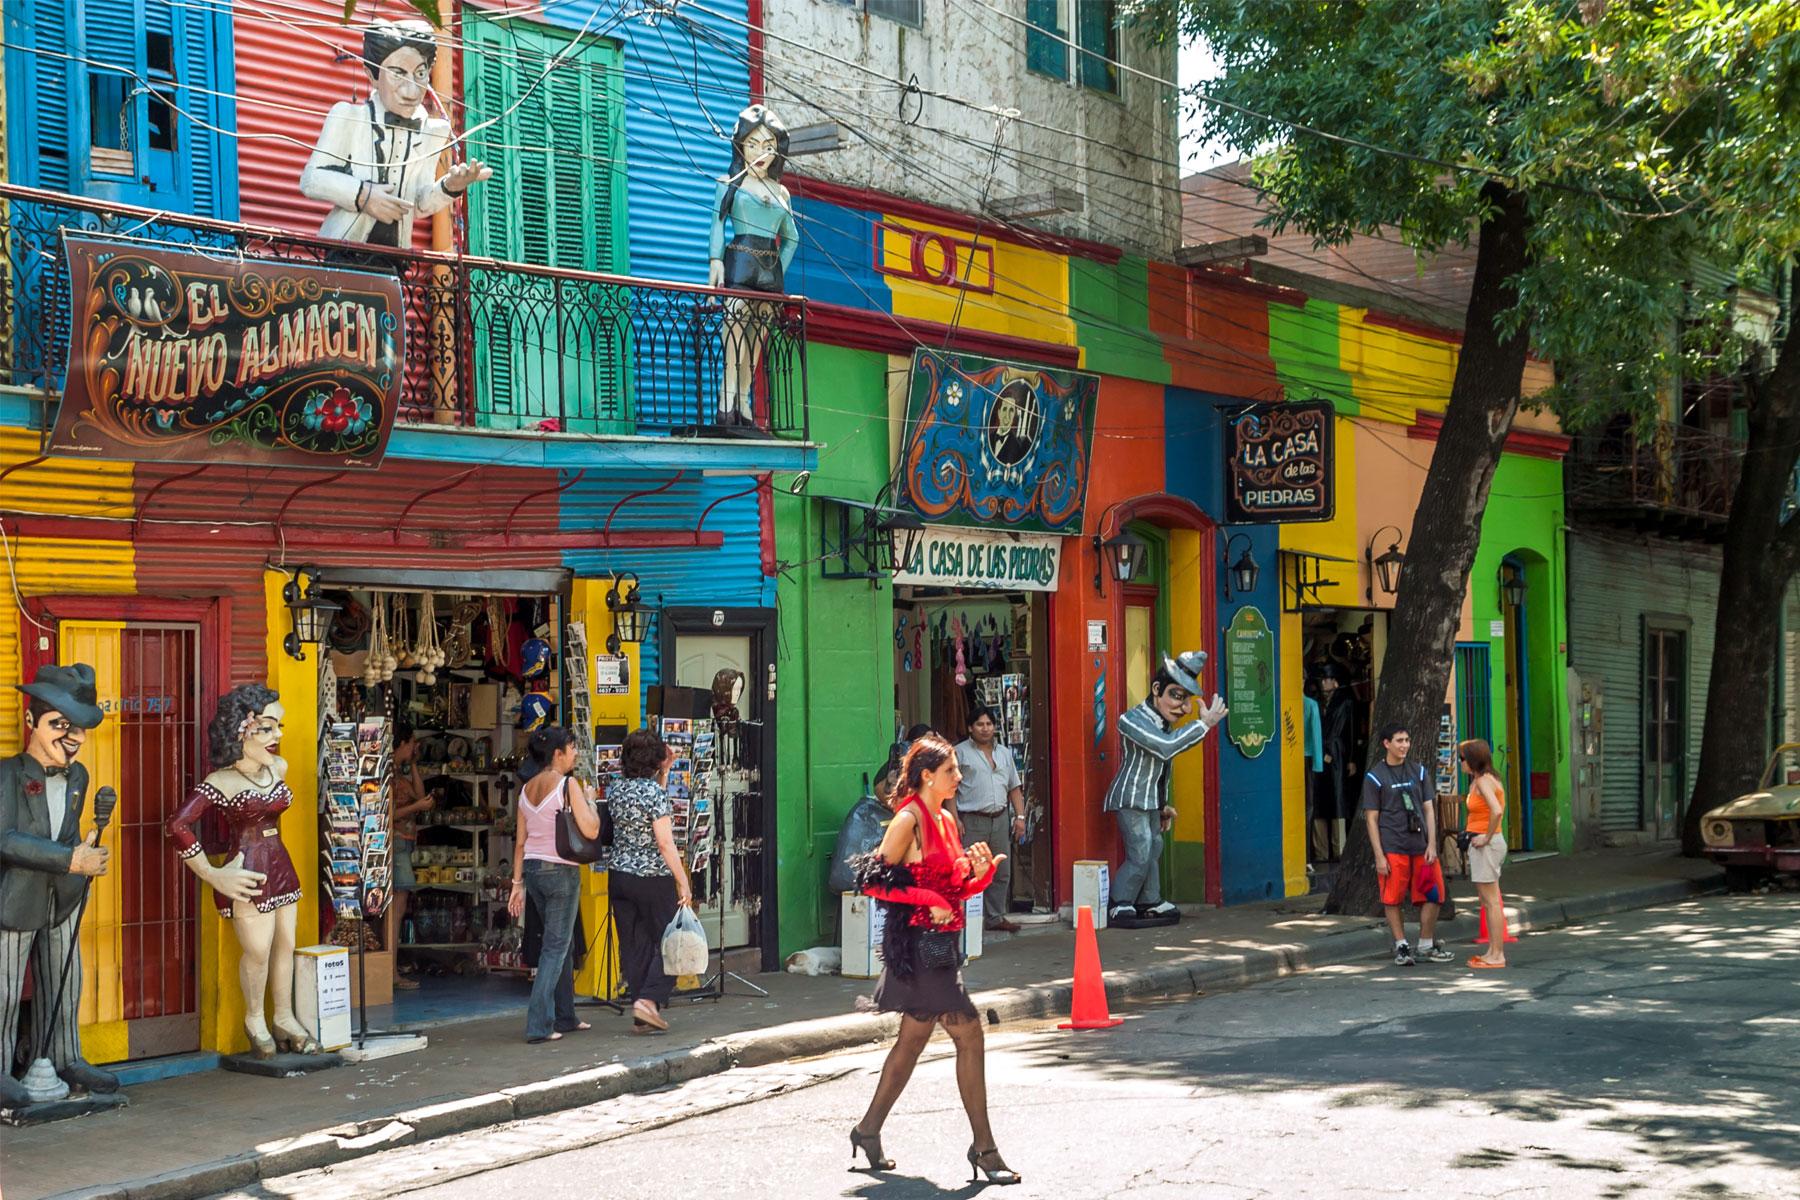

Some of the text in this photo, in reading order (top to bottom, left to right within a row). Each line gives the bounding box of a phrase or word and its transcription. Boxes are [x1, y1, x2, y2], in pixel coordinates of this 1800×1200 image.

[186, 281, 229, 329] EL
[122, 300, 377, 404] NUEVO ALMACEN
[1244, 430, 1319, 466] LA CASA
[1284, 461, 1316, 478] de las
[1245, 488, 1316, 506] PIEDRAS
[906, 540, 1056, 586] LA CASA DE LAS PIEDRAS
